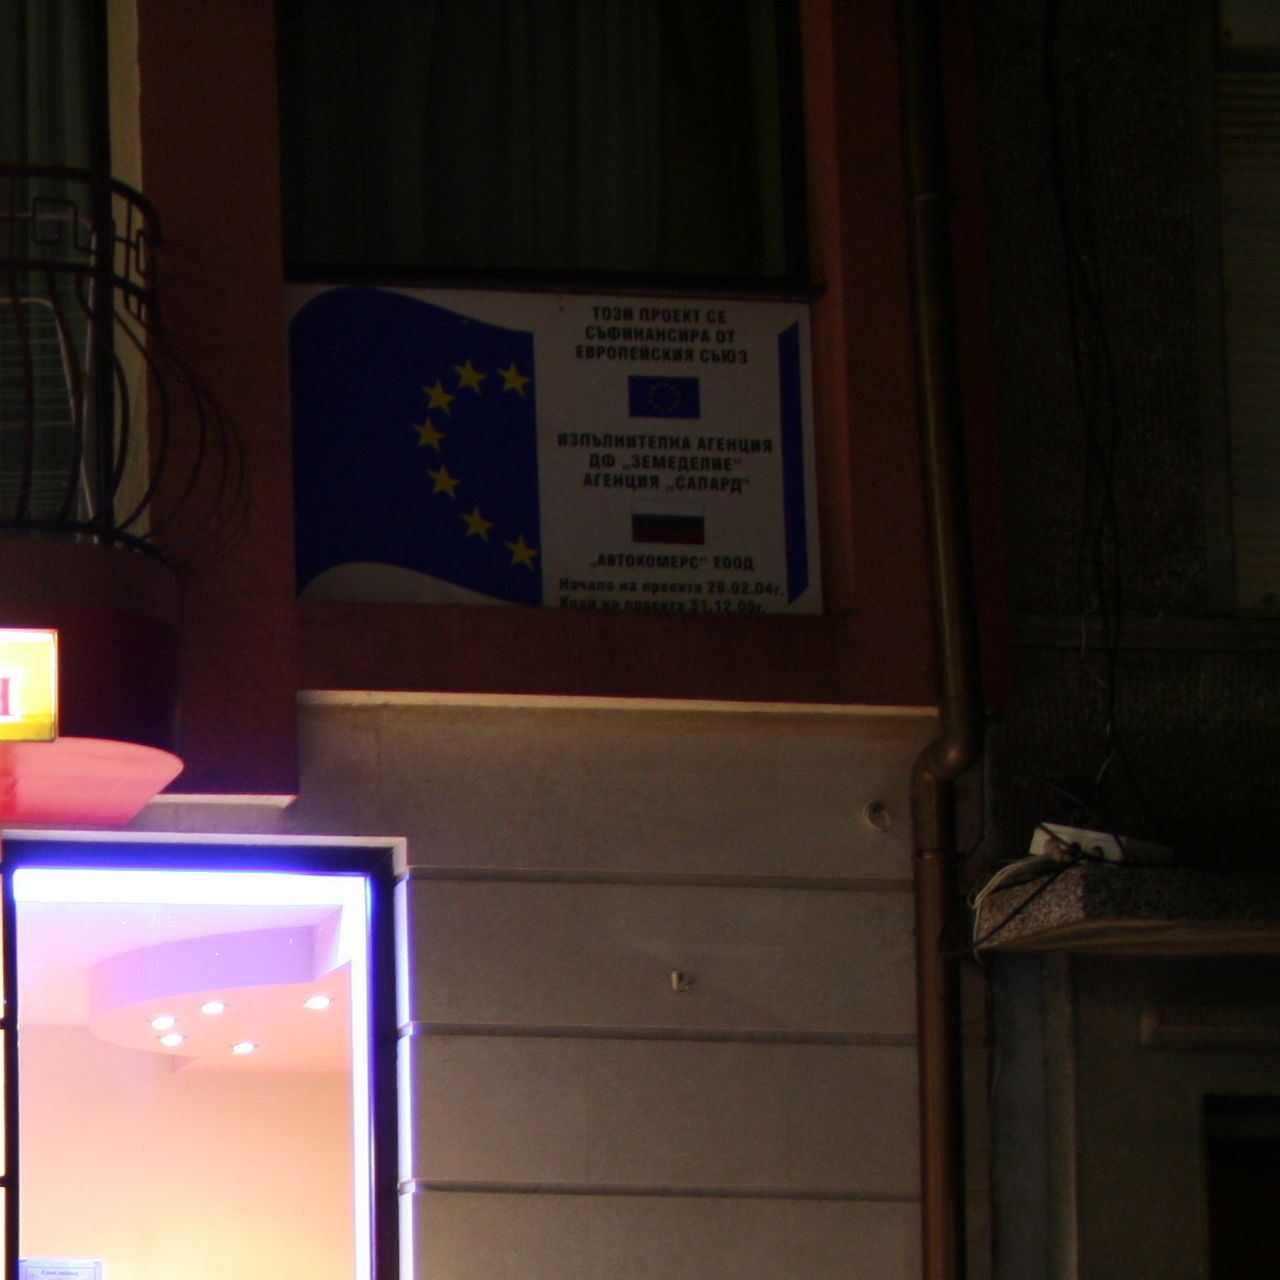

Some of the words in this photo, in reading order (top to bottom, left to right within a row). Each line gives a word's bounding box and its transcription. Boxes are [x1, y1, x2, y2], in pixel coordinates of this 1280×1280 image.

[592, 306, 634, 322] ТОЗИ
[639, 307, 702, 324] ПРОЕКТ
[706, 309, 727, 325] СЕ
[585, 325, 710, 343] СЪФИНАНСИРА
[715, 329, 735, 344] ОТ
[575, 344, 694, 363] ЕВРОПЕЙСКИЯ
[699, 349, 748, 365] СЪЮЗ
[557, 432, 691, 451] ИЗПЪЛНИТЕЛНА
[696, 437, 773, 455] АГЕНЦИЯ
[589, 453, 616, 469] ДФ
[583, 472, 660, 490] АГЕНЦИЯ
[713, 556, 755, 573] ЕООД
[559, 577, 614, 593] Начало
[619, 581, 638, 593] на
[642, 581, 703, 596] проекта
